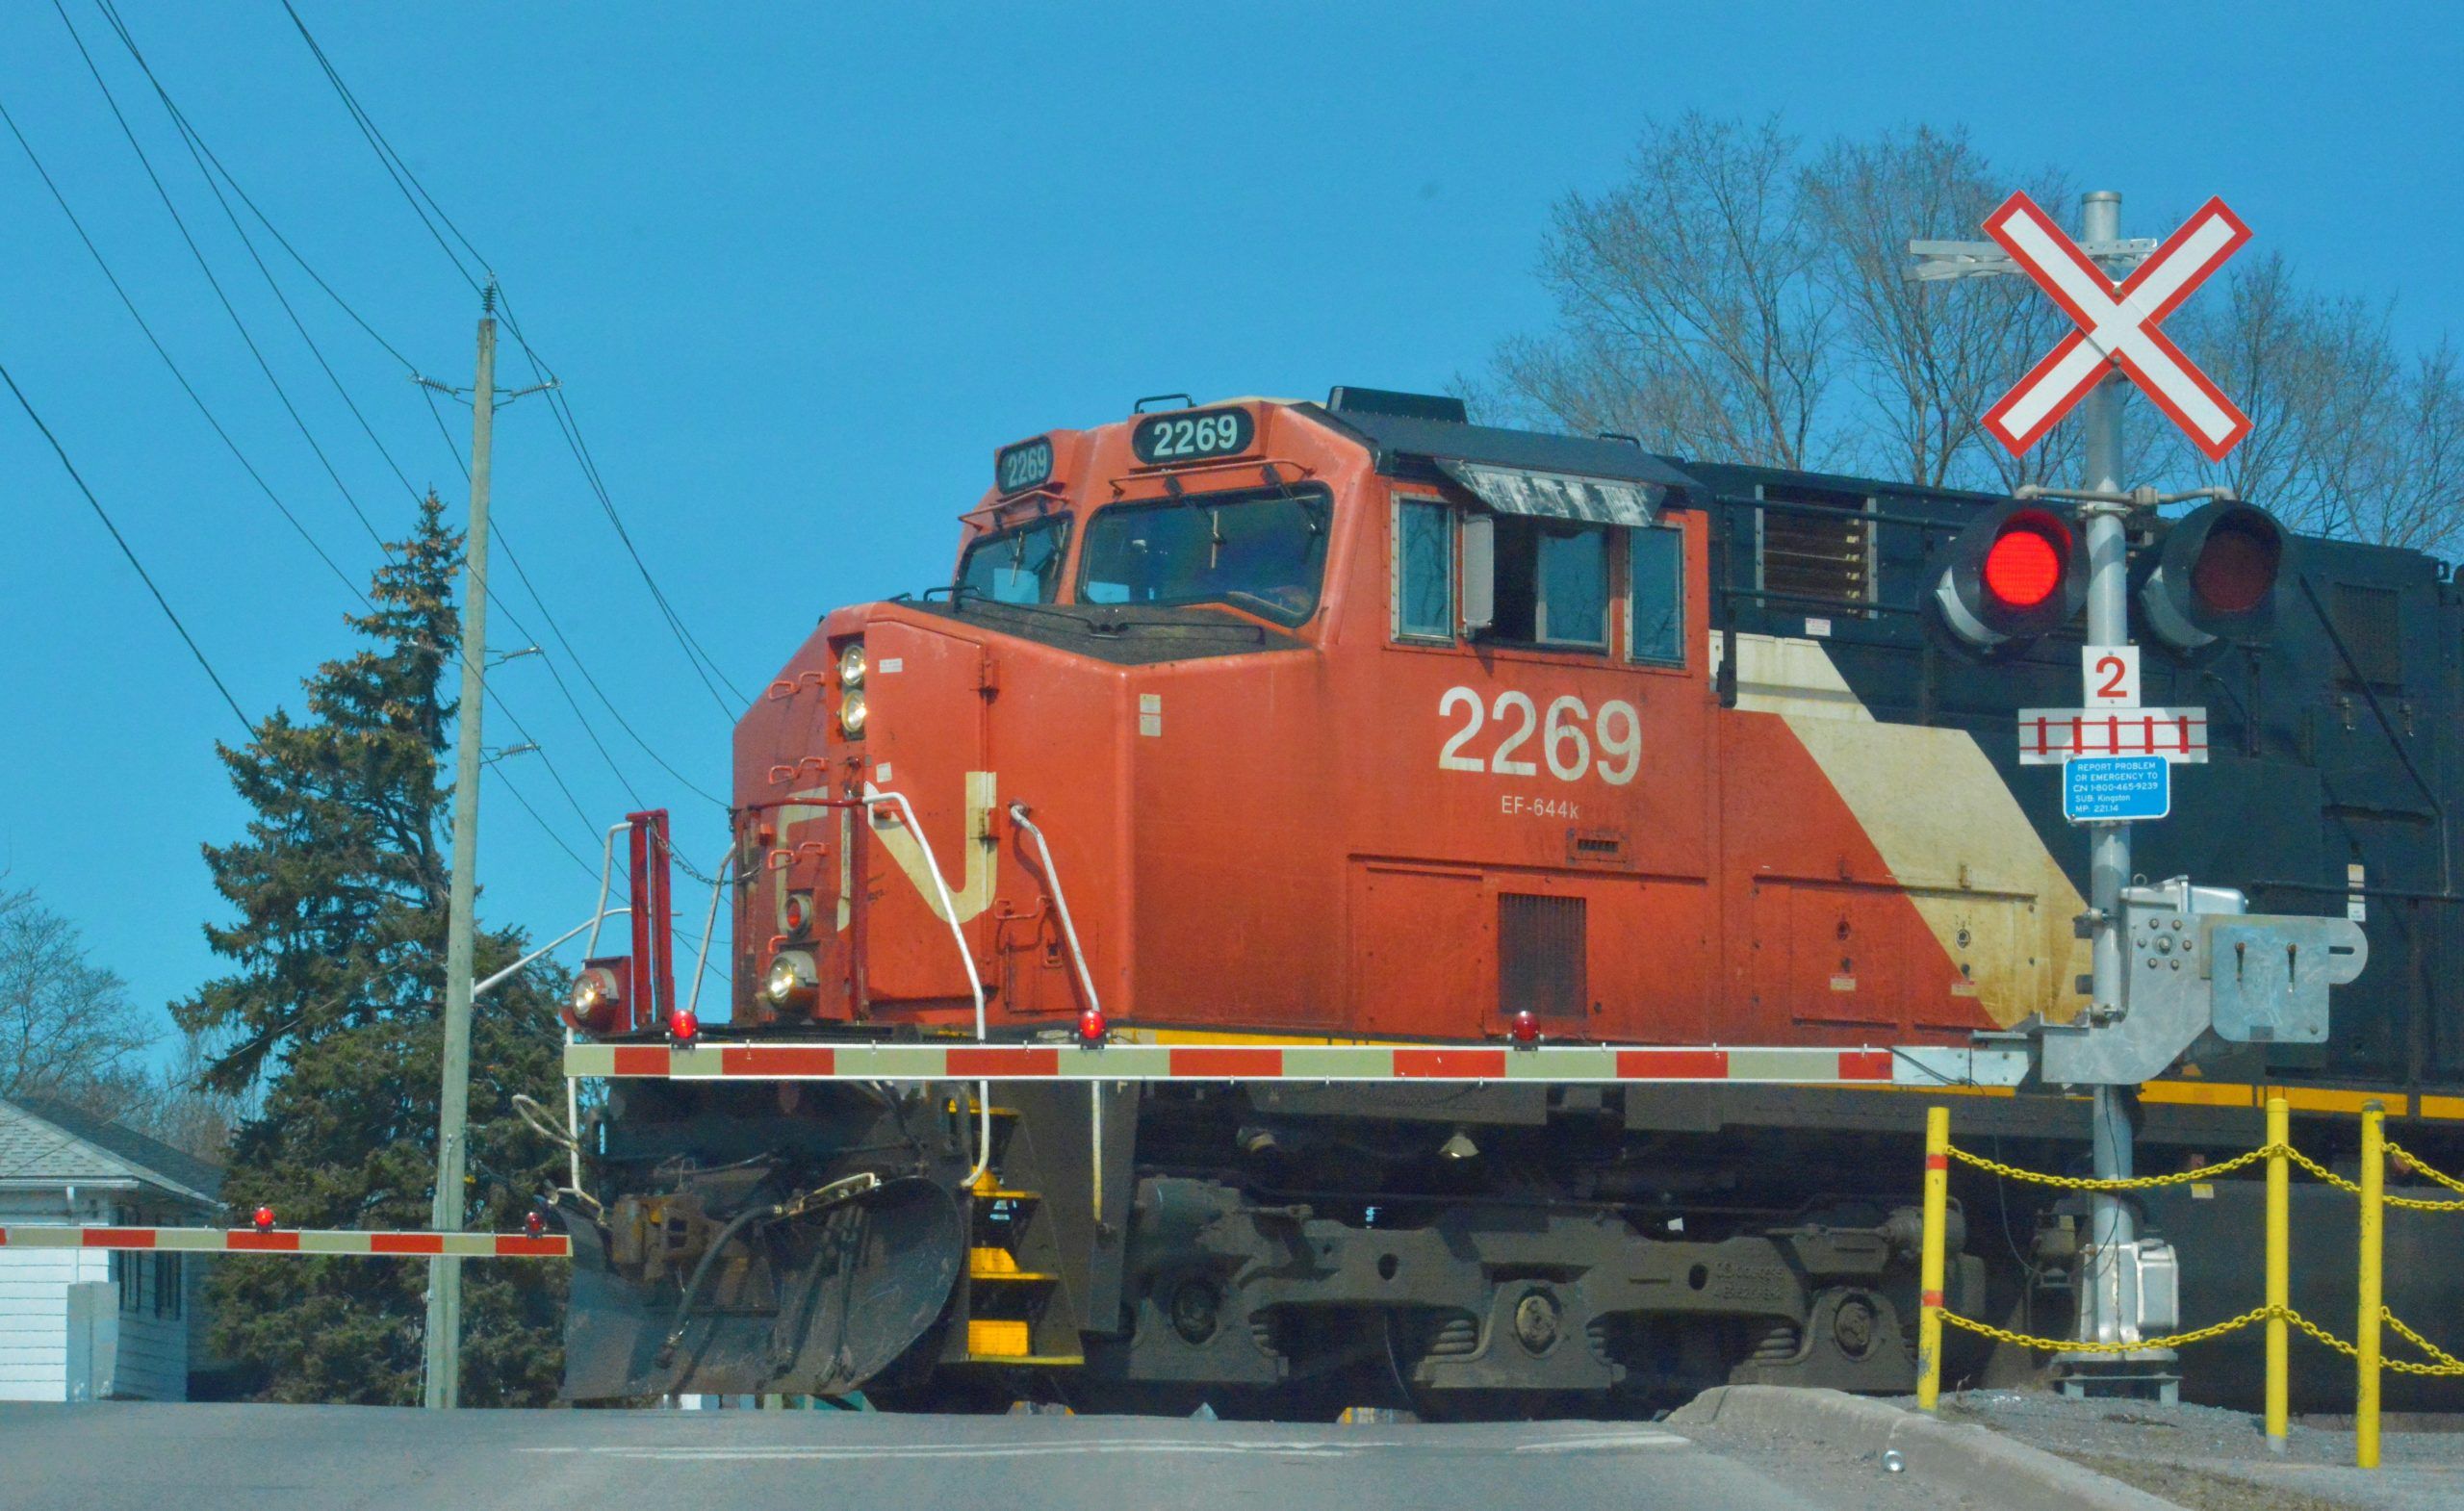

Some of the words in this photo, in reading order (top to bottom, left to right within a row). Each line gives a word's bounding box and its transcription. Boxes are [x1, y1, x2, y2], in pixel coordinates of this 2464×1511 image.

[1152, 414, 1238, 456] 2269
[1007, 444, 1048, 487] 2269
[2095, 655, 2127, 698] 2
[1438, 685, 1642, 786] 2269
[2077, 762, 2112, 772] REPORT
[2115, 761, 2156, 771] PROBLEM
[2091, 772, 2144, 781] EMERGENCY
[2091, 781, 2158, 792] 1-800-465-9239
[2097, 794, 2131, 804] Kingston
